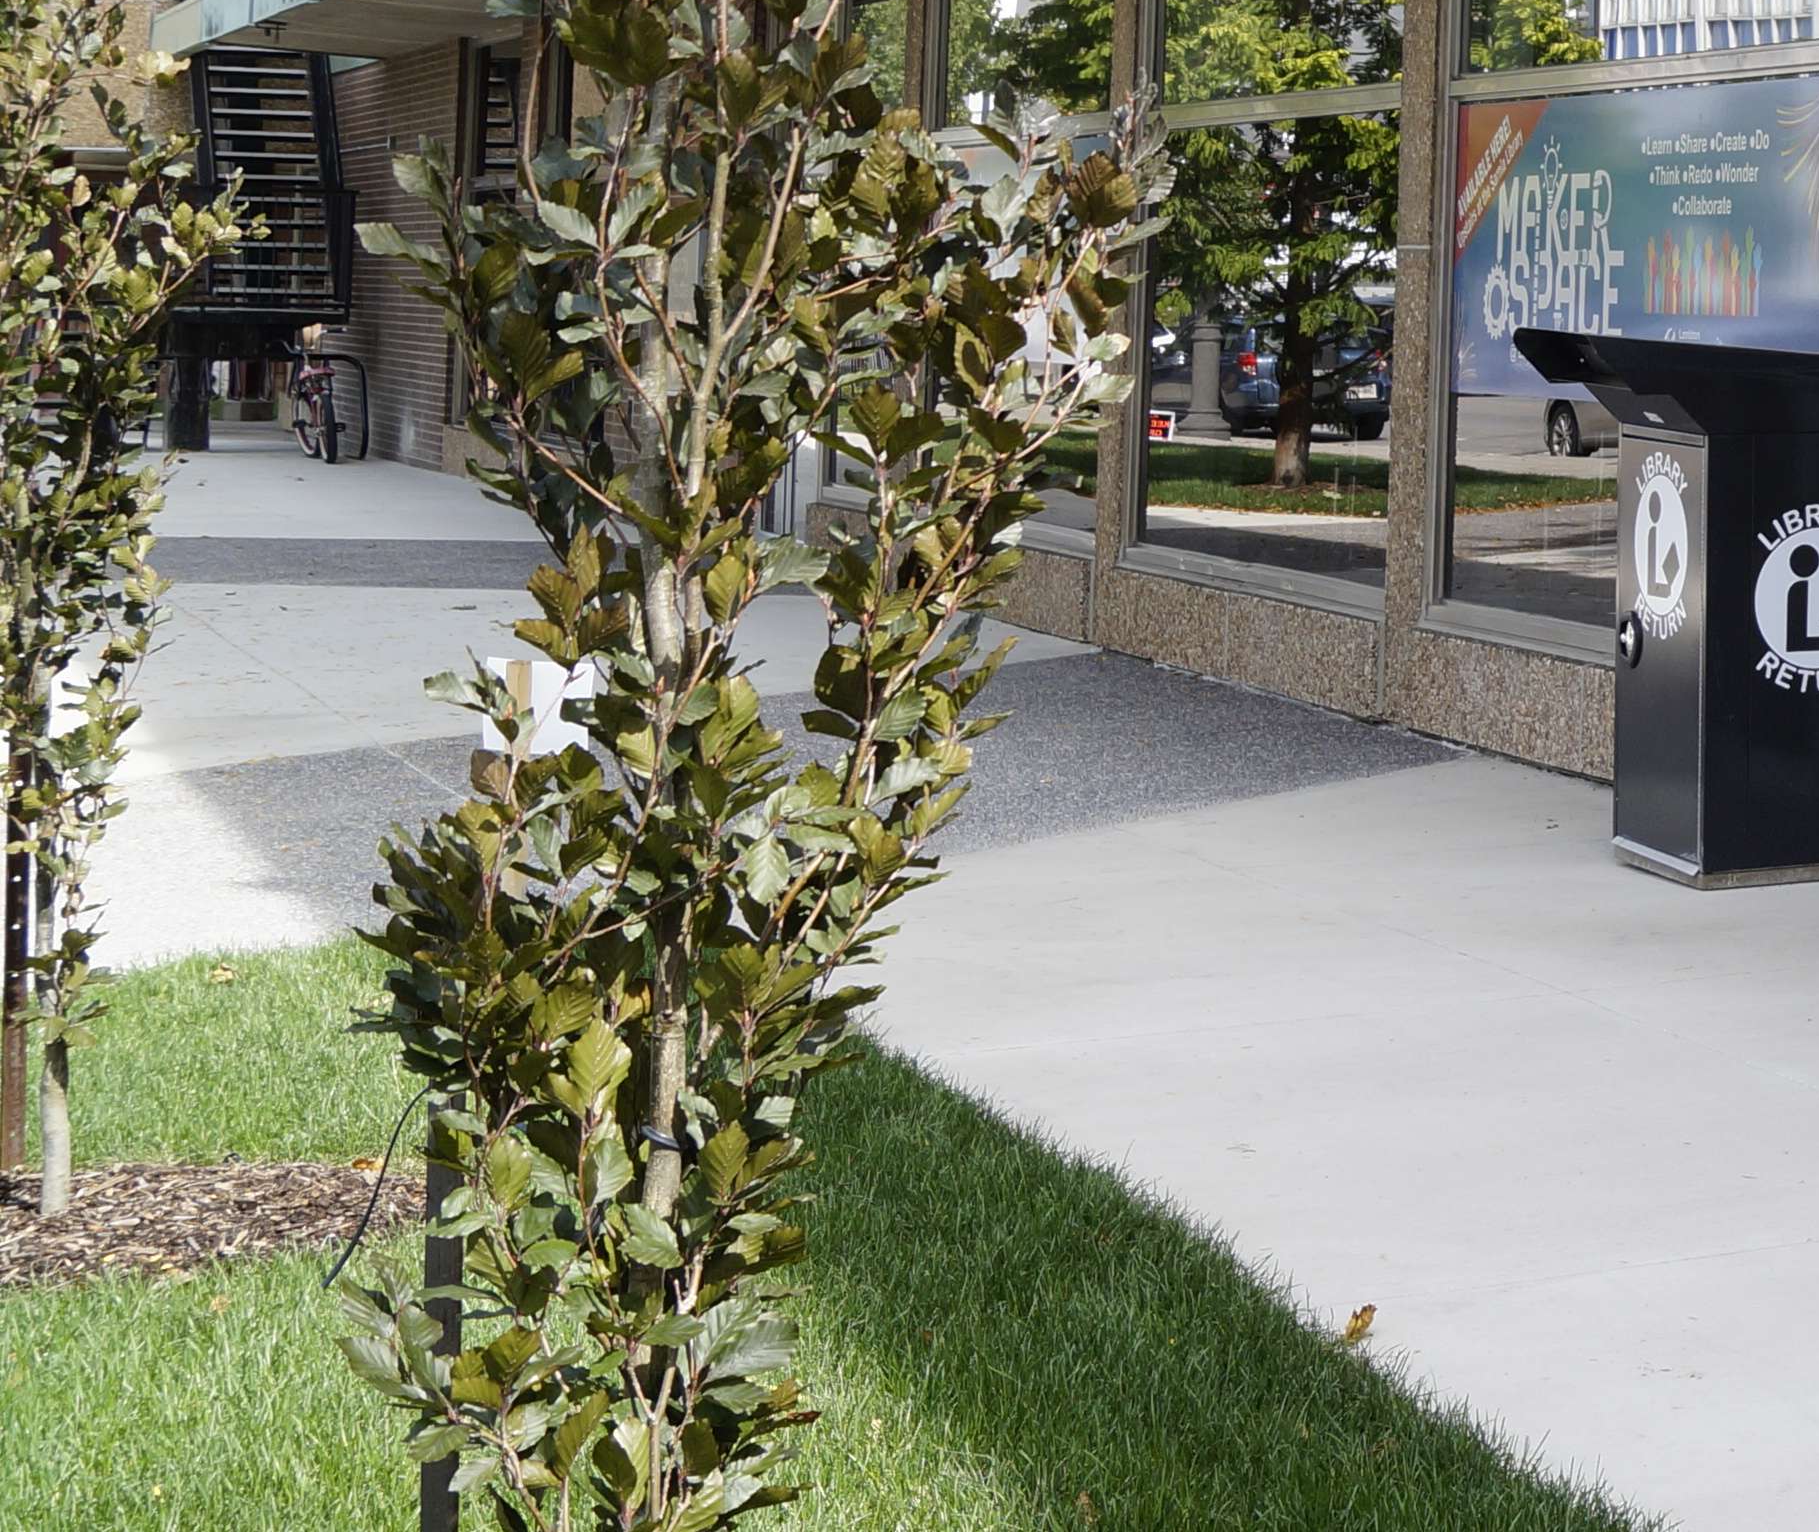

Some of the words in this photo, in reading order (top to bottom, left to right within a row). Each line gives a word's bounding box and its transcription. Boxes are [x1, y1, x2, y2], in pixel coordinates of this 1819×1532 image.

[1646, 135, 1673, 156] Learn
[1680, 133, 1708, 154] Share
[1715, 131, 1747, 152] Create
[1755, 129, 1770, 150] Do
[1456, 149, 1492, 221] AVAILABLE
[1489, 114, 1513, 162] HERE!
[1654, 165, 1681, 186] Think
[1688, 164, 1713, 184] Redo
[1720, 162, 1760, 183] Wonder
[1497, 170, 1613, 264] MAKER
[1678, 195, 1732, 216] Collaborate
[1508, 251, 1624, 336] SPACE
[1635, 452, 1688, 494] LIBRARY
[1634, 592, 1688, 640] RETURN
